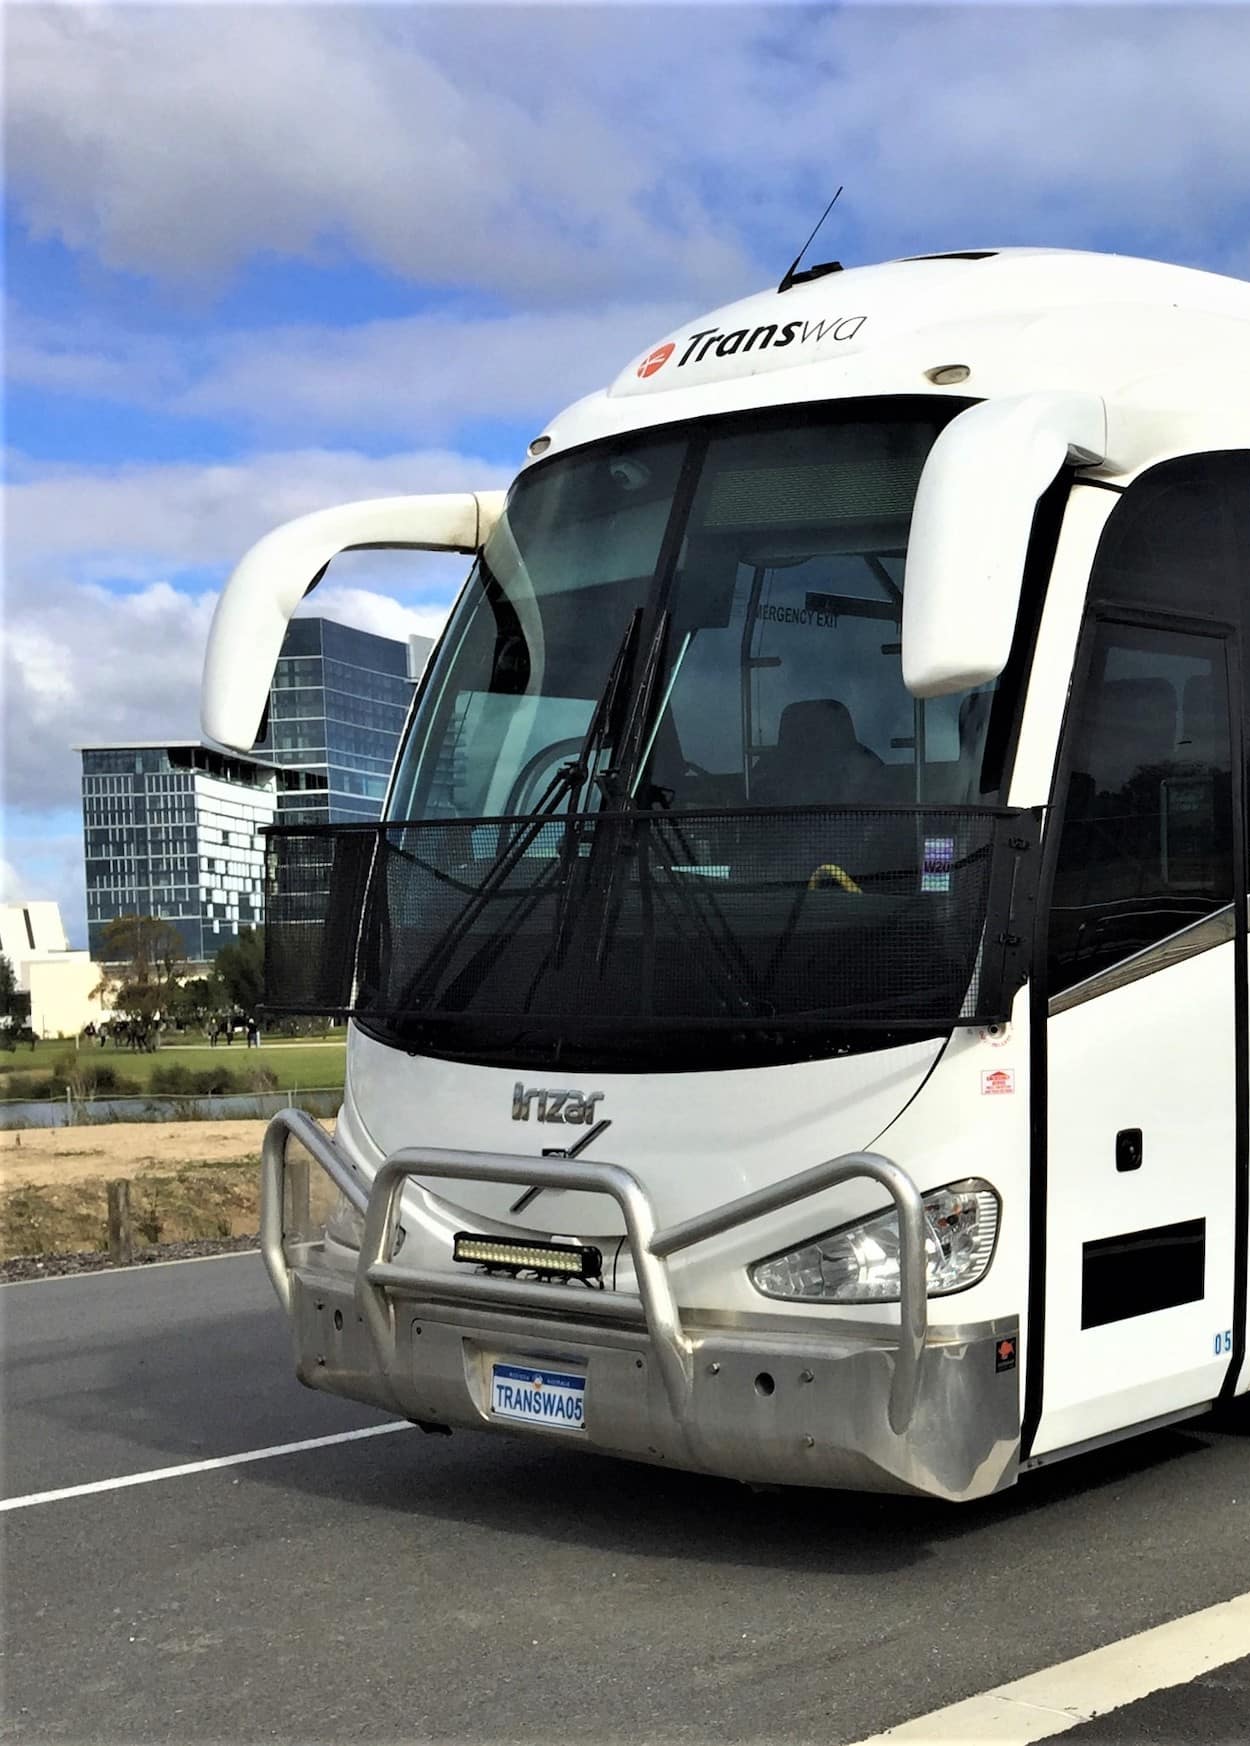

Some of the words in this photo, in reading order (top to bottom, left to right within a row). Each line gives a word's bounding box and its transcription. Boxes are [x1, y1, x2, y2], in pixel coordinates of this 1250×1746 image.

[677, 316, 868, 367] Transwa
[512, 1082, 605, 1125] Irizar
[496, 1384, 583, 1420] TRANSWA05
